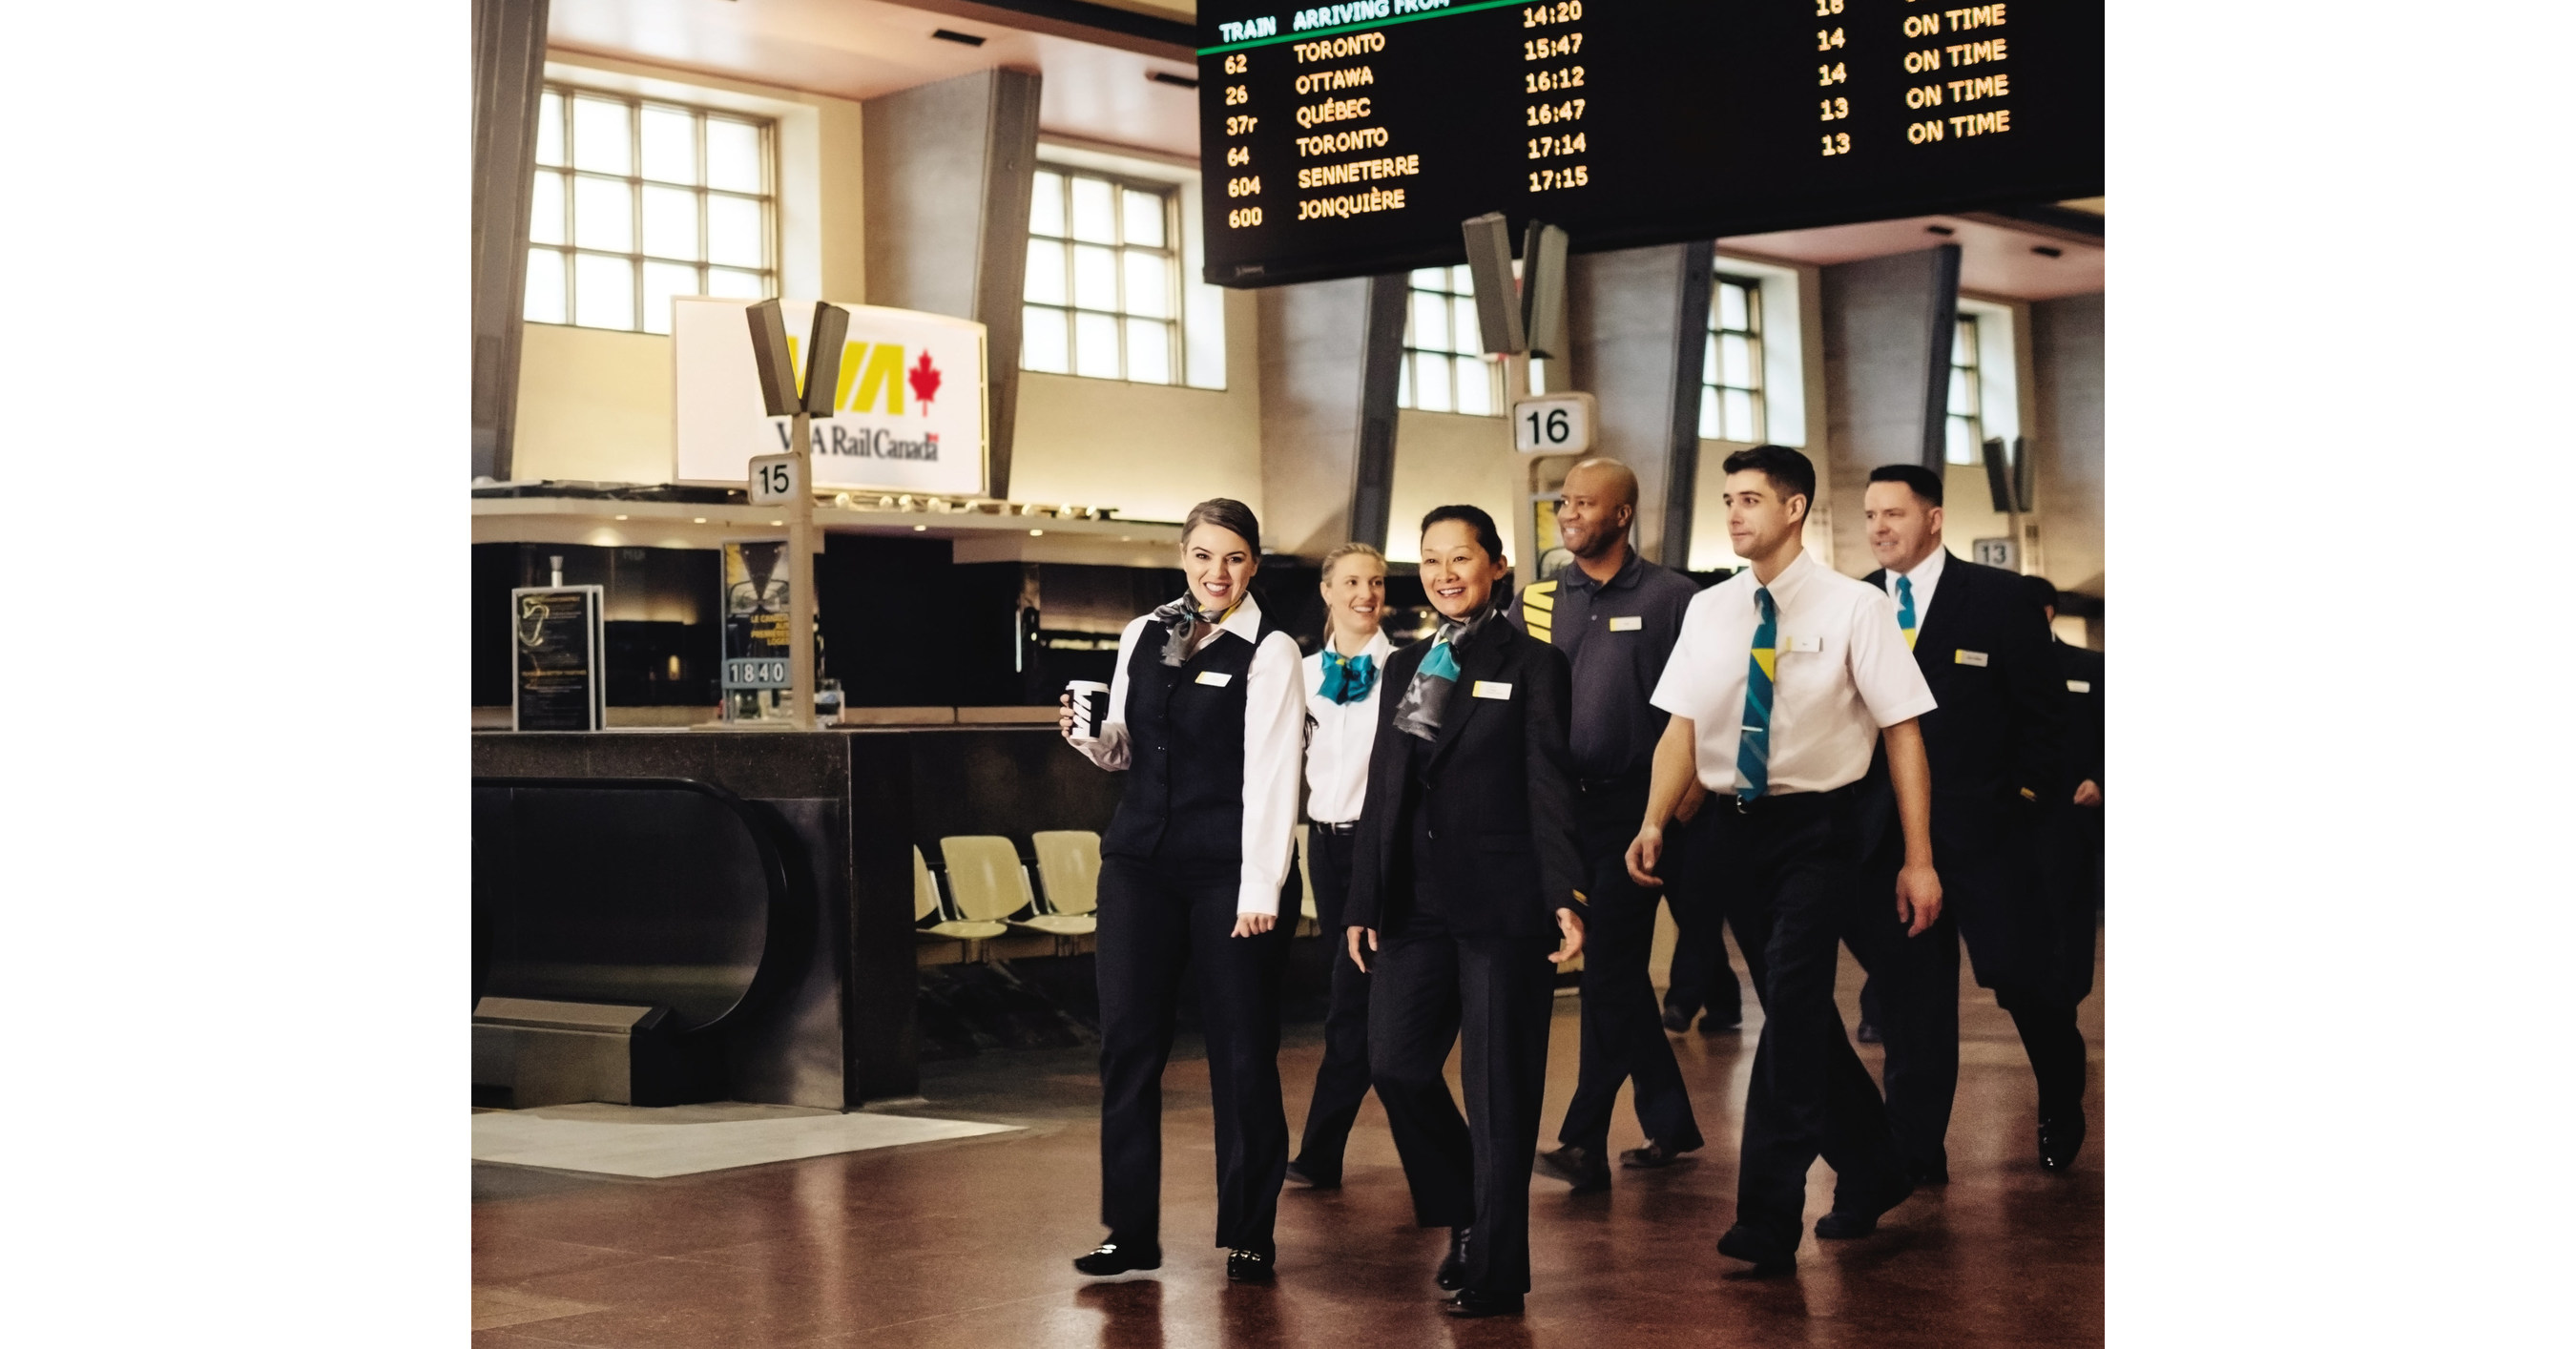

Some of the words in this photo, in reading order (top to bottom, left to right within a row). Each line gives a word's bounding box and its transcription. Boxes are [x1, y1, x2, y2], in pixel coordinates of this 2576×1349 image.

[1218, 15, 1277, 43] TRAIN
[1293, 0, 1390, 31] ARRIVING
[1224, 53, 1248, 74] 62
[1294, 31, 1386, 64] TORONTO
[1523, 0, 1583, 29] 14:20
[1225, 84, 1249, 106] 26
[1295, 65, 1374, 95] OTTAWA
[1524, 31, 1584, 61] 15:47
[1226, 114, 1258, 136] 37r
[1296, 96, 1372, 130] QUÉBEC
[1525, 65, 1585, 94] 16:12
[1817, 27, 1846, 52] 14
[1902, 12, 1941, 39] ON
[1944, 3, 2007, 32] TIME
[1227, 145, 1251, 167] 64
[1296, 126, 1389, 157] TORONTO
[1526, 98, 1587, 127] 16:47
[1818, 61, 1848, 87] 14
[1903, 48, 1942, 74] ON
[1945, 37, 2008, 68] TIME
[1227, 175, 1262, 198] 604
[1298, 154, 1420, 189] SENNETERRE
[1527, 132, 1588, 159] 17:14
[1820, 96, 1850, 122] 13
[1905, 84, 1943, 110] ON
[1947, 73, 2010, 103] TIME
[1228, 206, 1263, 229] 600
[1298, 186, 1406, 221] JONQUIÈRE
[1528, 165, 1589, 193] 17:15
[1821, 132, 1852, 156] 13
[1907, 119, 1944, 145] ON
[1948, 109, 2011, 138] TIME
[776, 422, 827, 456] VA
[831, 425, 872, 458] Rail
[873, 428, 939, 462] Canada
[1526, 408, 1570, 445] 16
[759, 464, 790, 495] 15
[1981, 544, 2007, 565] 13
[731, 662, 784, 683] 1840
